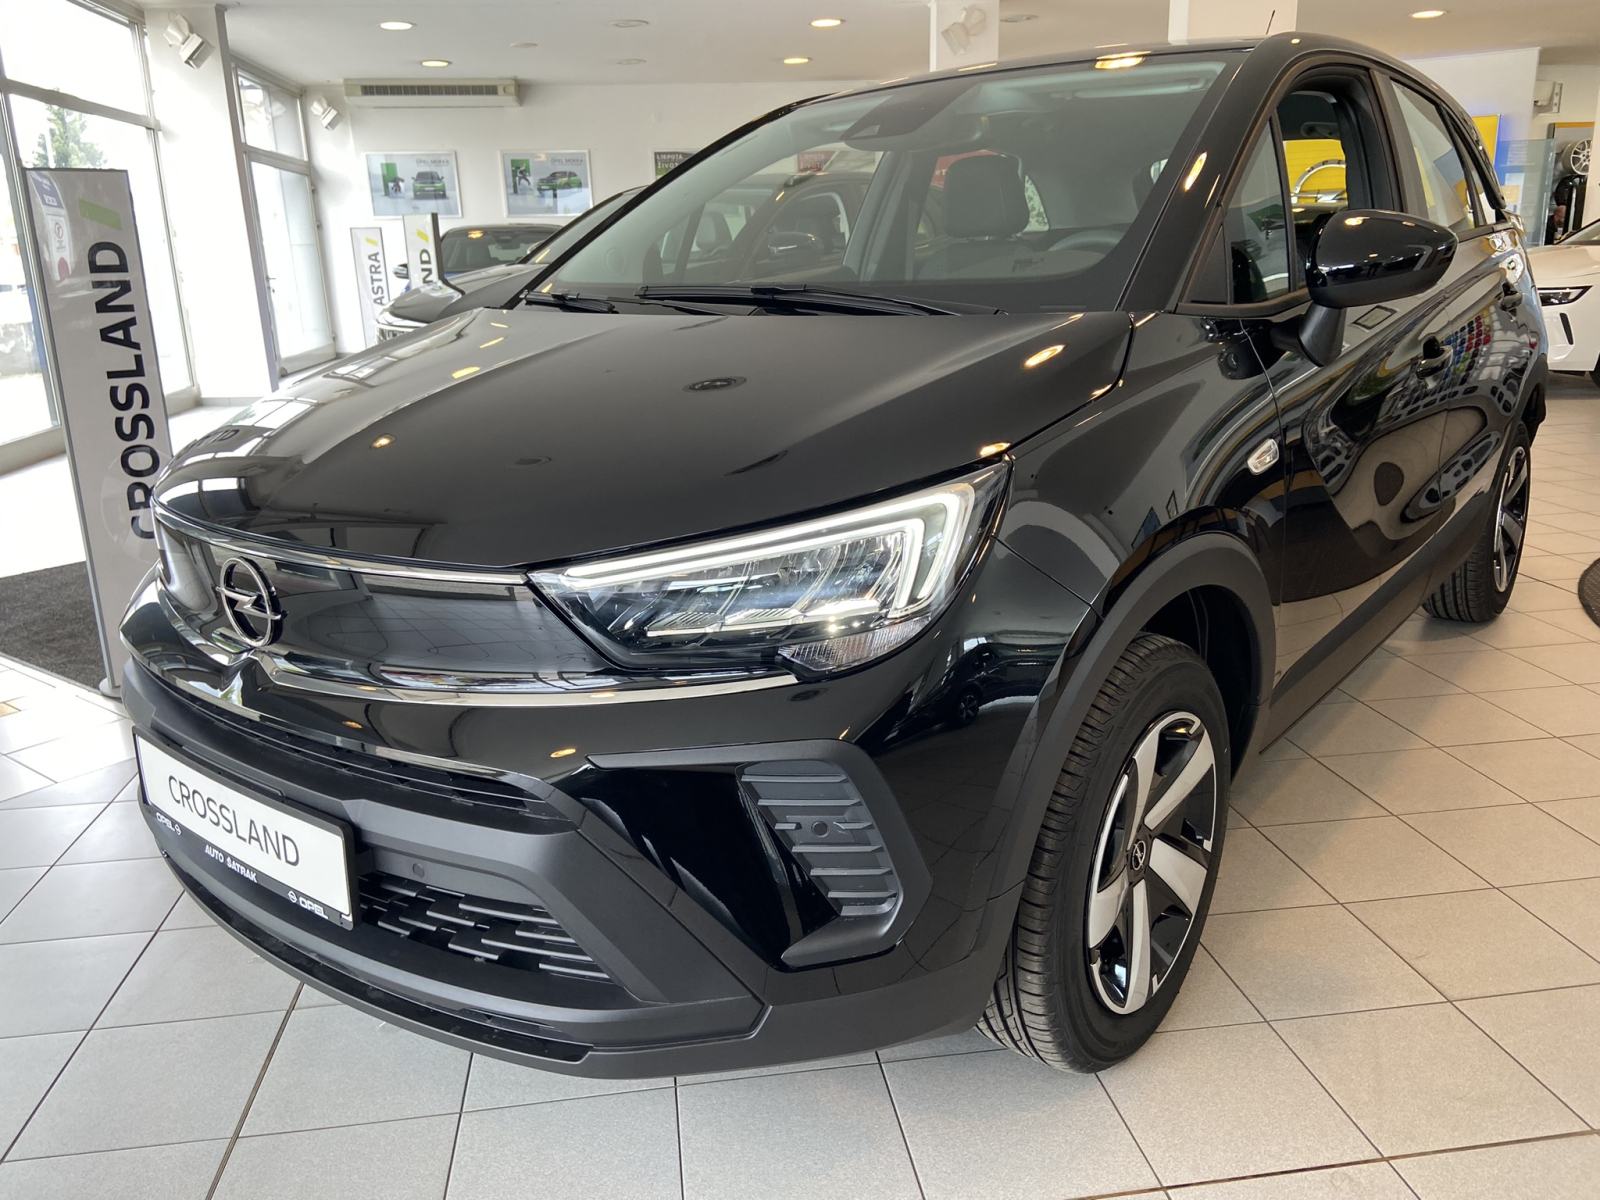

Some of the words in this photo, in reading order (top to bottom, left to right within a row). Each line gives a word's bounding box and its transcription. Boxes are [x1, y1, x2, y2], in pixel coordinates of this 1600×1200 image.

[367, 251, 386, 306] ASTRA
[87, 241, 160, 539] CROSSLAND
[156, 812, 176, 832] OPEL
[168, 775, 300, 867] CROSSLAND
[204, 844, 225, 864] AUTO
[299, 896, 329, 920] OPEL
